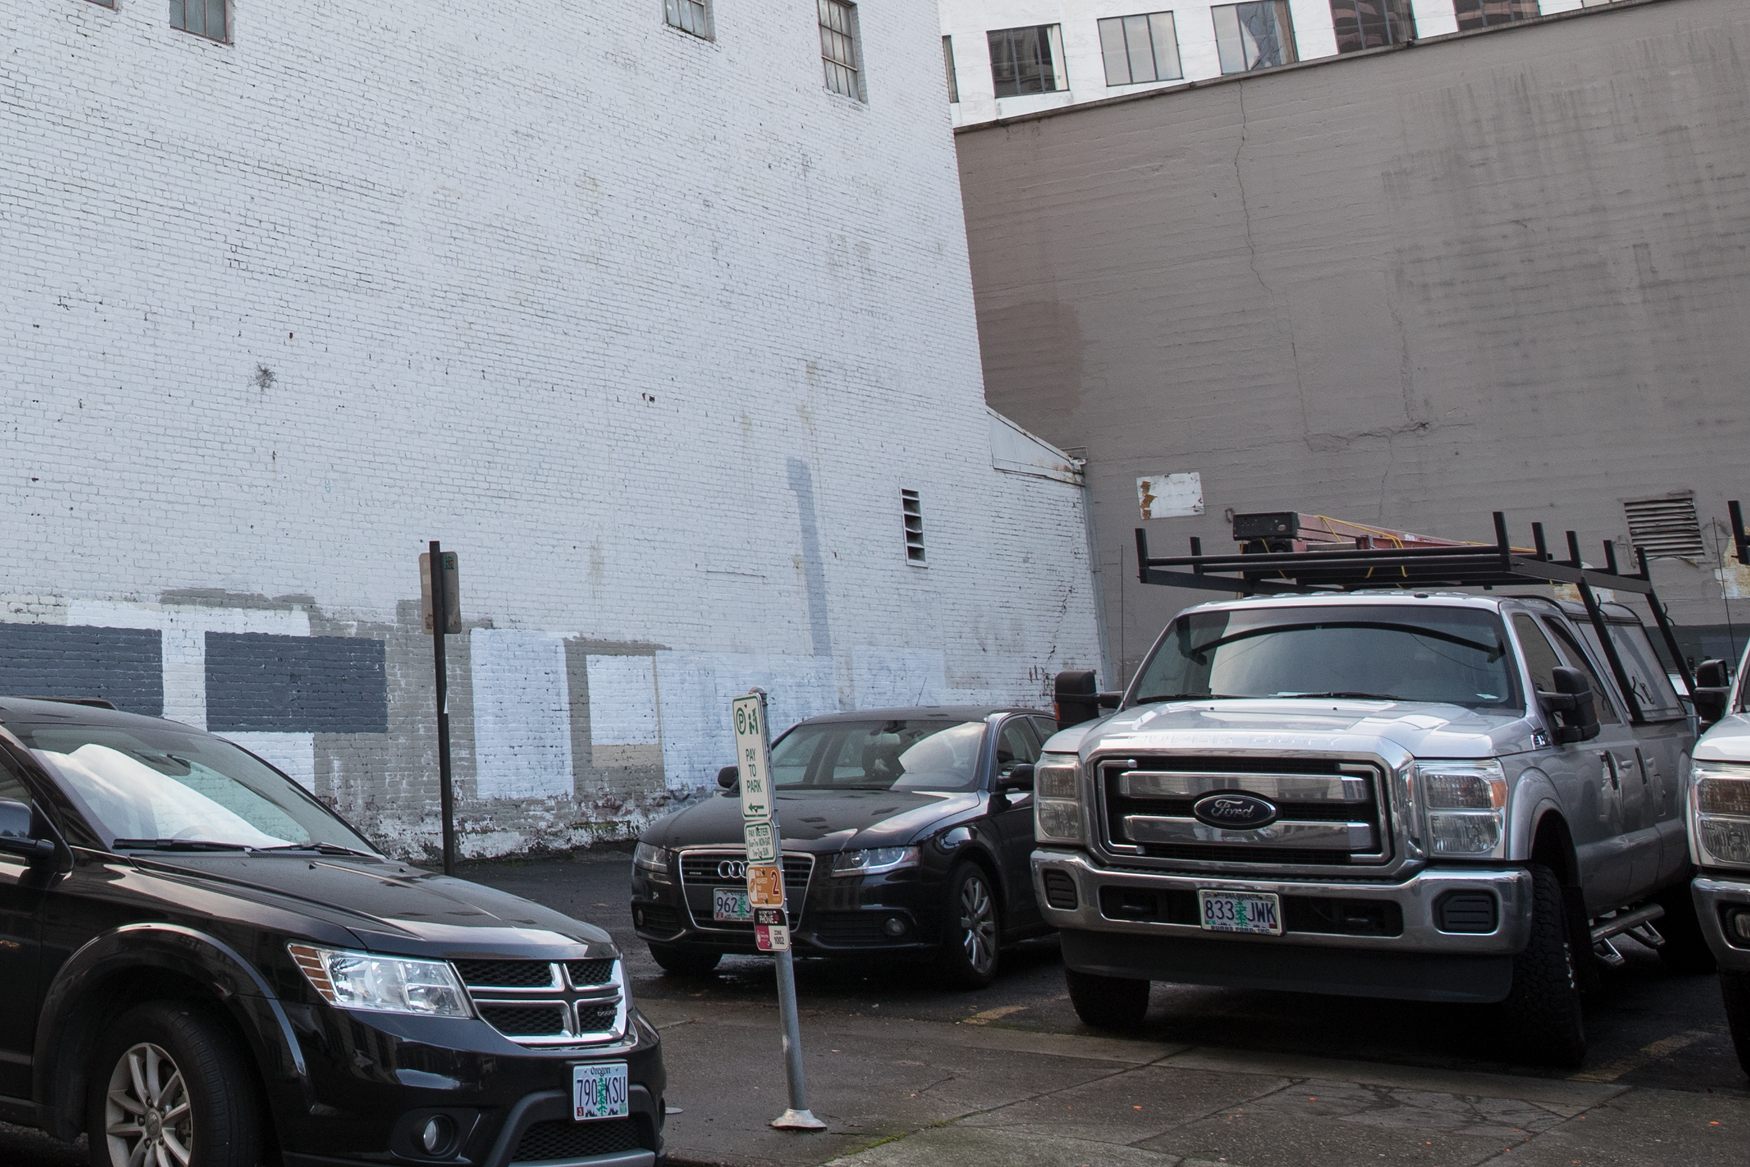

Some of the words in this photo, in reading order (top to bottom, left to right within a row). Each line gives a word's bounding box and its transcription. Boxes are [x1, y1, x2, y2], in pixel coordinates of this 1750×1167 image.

[1128, 734, 1234, 745] SUPER
[1250, 736, 1343, 747] DUTY
[745, 748, 756, 762] PAY
[748, 764, 757, 777] TO
[746, 779, 762, 793] PARK
[1211, 799, 1255, 819] Ford
[771, 870, 780, 896] 2
[716, 896, 738, 913] 962
[1205, 900, 1235, 920] 833
[1247, 902, 1277, 923] JWK
[759, 914, 774, 924] PHONE
[590, 1066, 611, 1077] Oregon
[576, 1078, 598, 1106] 790
[605, 1076, 626, 1105] KSU
